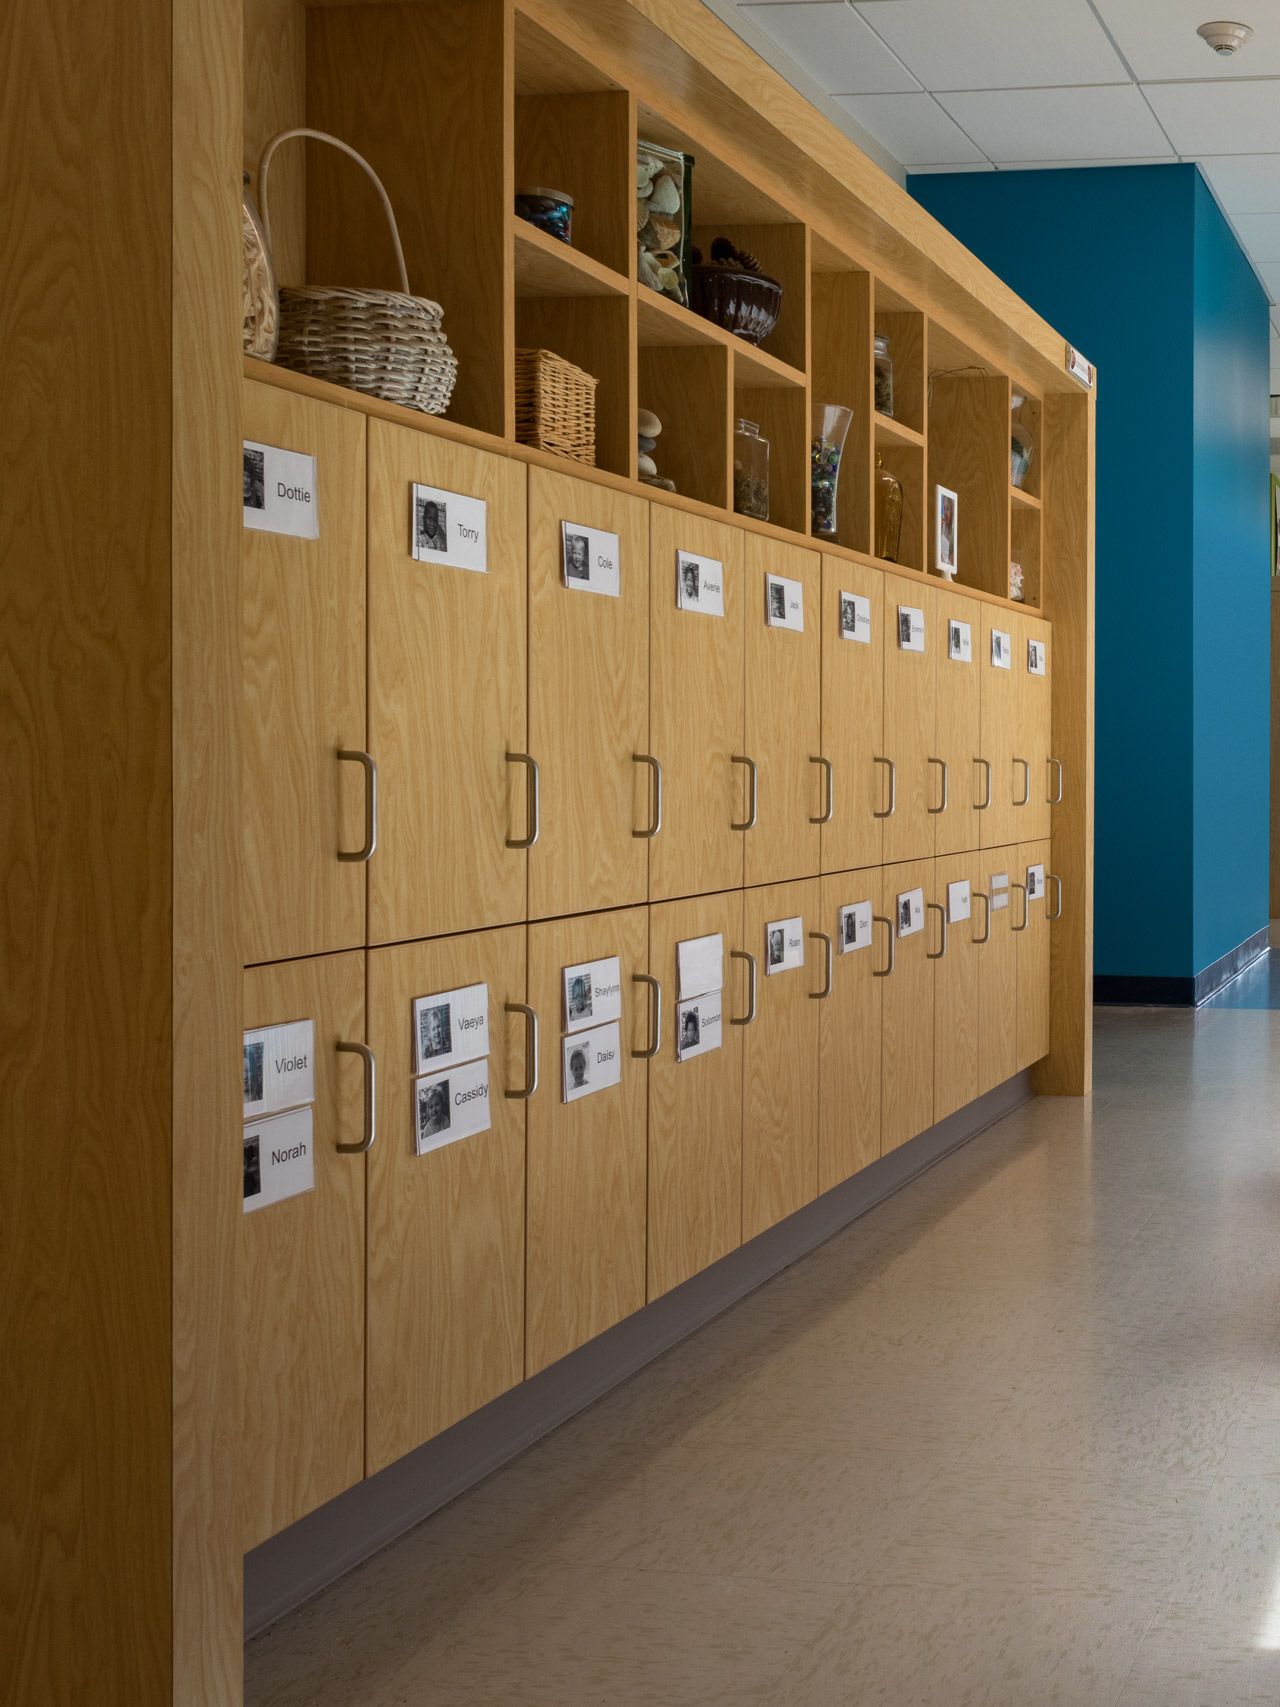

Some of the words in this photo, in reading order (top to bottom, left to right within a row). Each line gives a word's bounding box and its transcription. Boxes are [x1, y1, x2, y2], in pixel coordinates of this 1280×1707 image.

[277, 482, 311, 503] Dottie
[457, 523, 479, 544] Torry
[597, 555, 613, 570] Cole
[457, 1014, 484, 1032] Vaeya
[275, 1054, 308, 1074] Violet
[454, 1083, 489, 1106] Cassidy
[271, 1142, 307, 1166] Norah
